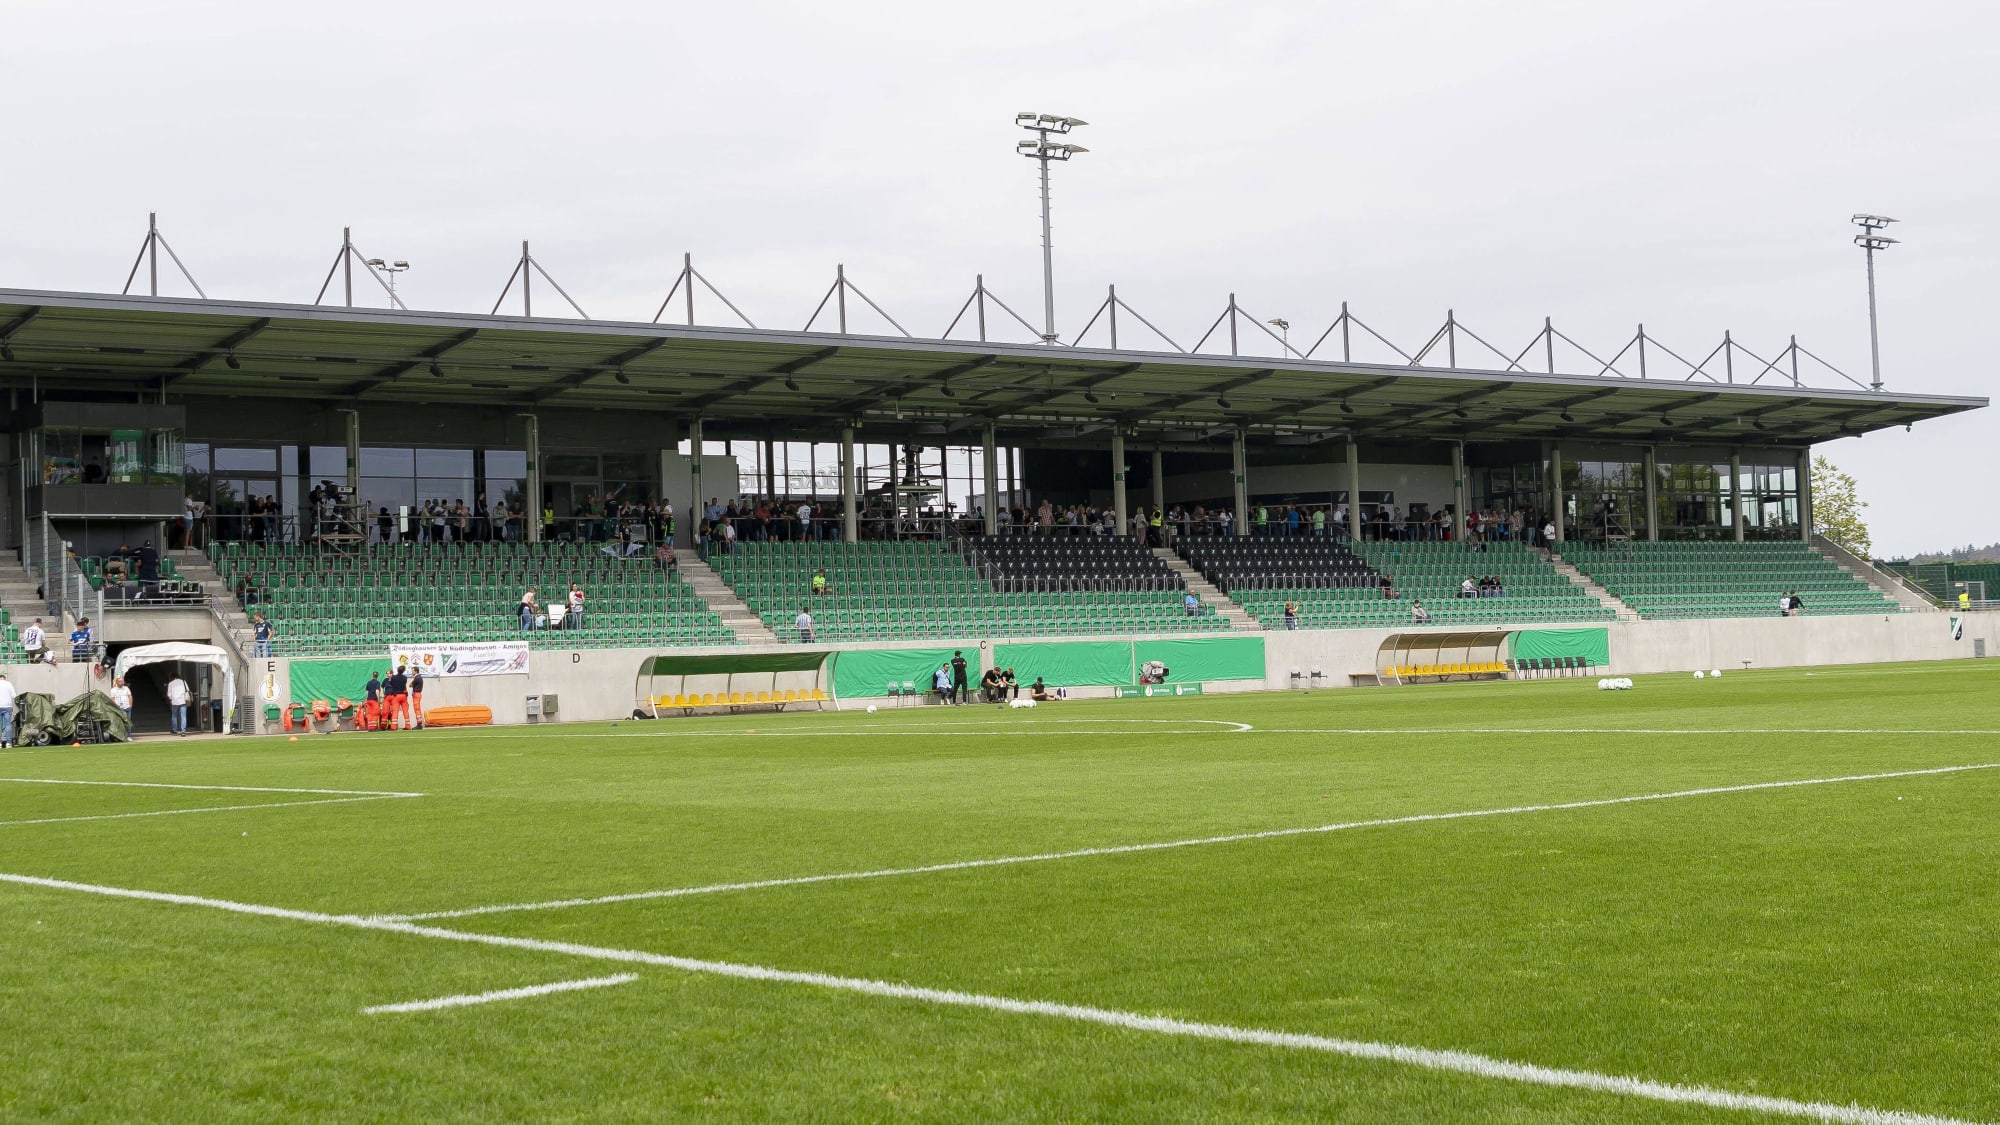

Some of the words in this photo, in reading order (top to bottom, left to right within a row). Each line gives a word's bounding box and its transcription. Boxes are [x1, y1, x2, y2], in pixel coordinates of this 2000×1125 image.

[980, 640, 987, 649] C
[572, 653, 581, 663] D
[268, 661, 276, 672] E
